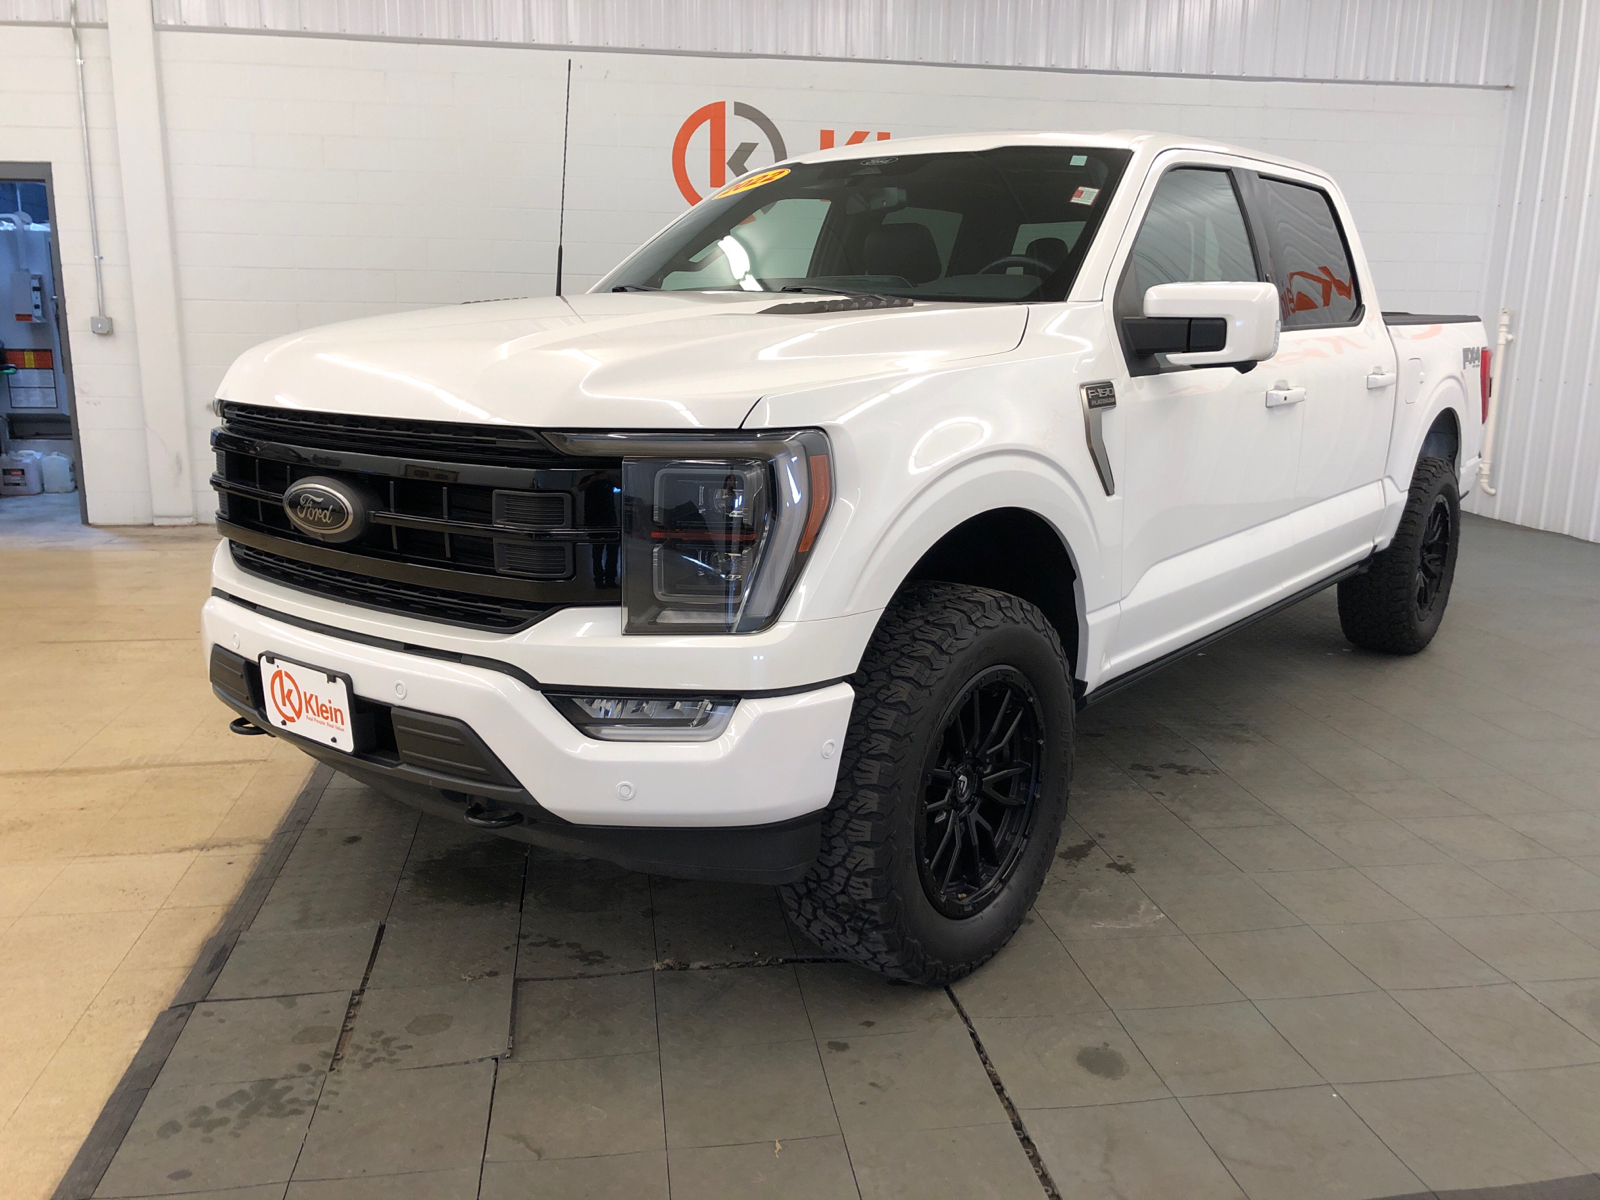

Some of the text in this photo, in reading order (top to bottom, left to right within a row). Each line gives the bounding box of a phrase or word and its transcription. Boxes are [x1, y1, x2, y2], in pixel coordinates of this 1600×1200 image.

[1087, 387, 1114, 399] F-150
[297, 493, 334, 524] Ford
[303, 691, 345, 726] Klein
